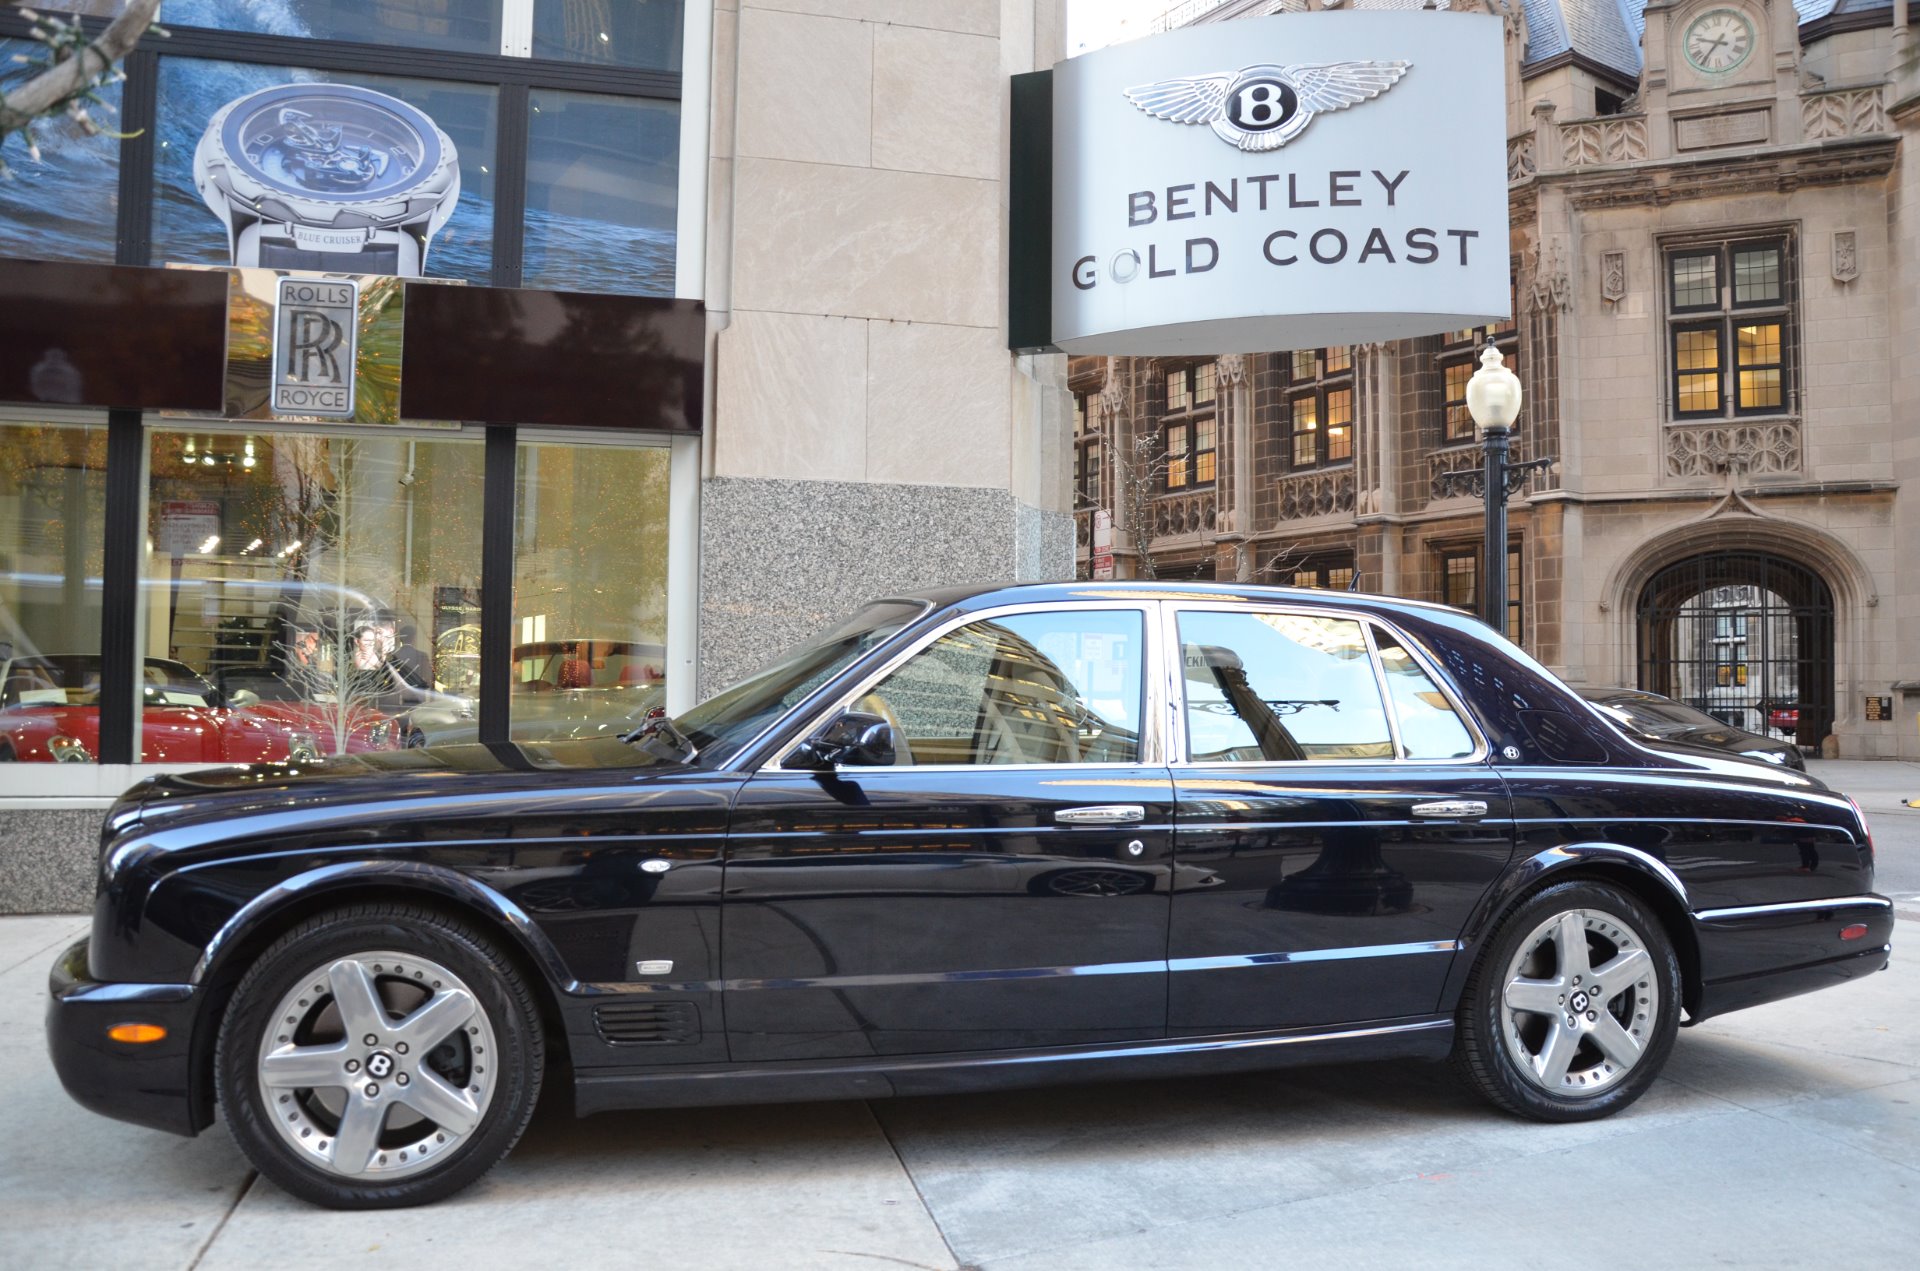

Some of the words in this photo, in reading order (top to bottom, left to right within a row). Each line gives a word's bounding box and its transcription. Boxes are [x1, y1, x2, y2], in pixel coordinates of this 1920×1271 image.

[1238, 83, 1284, 127] B
[1128, 170, 1411, 228] BENTLEY
[297, 231, 321, 243] BLUE
[323, 235, 361, 245] CRUISER
[1072, 237, 1220, 291] GOLD
[1263, 228, 1480, 267] COAST
[285, 285, 349, 304] ROLLS
[280, 389, 345, 407] ROYCE
